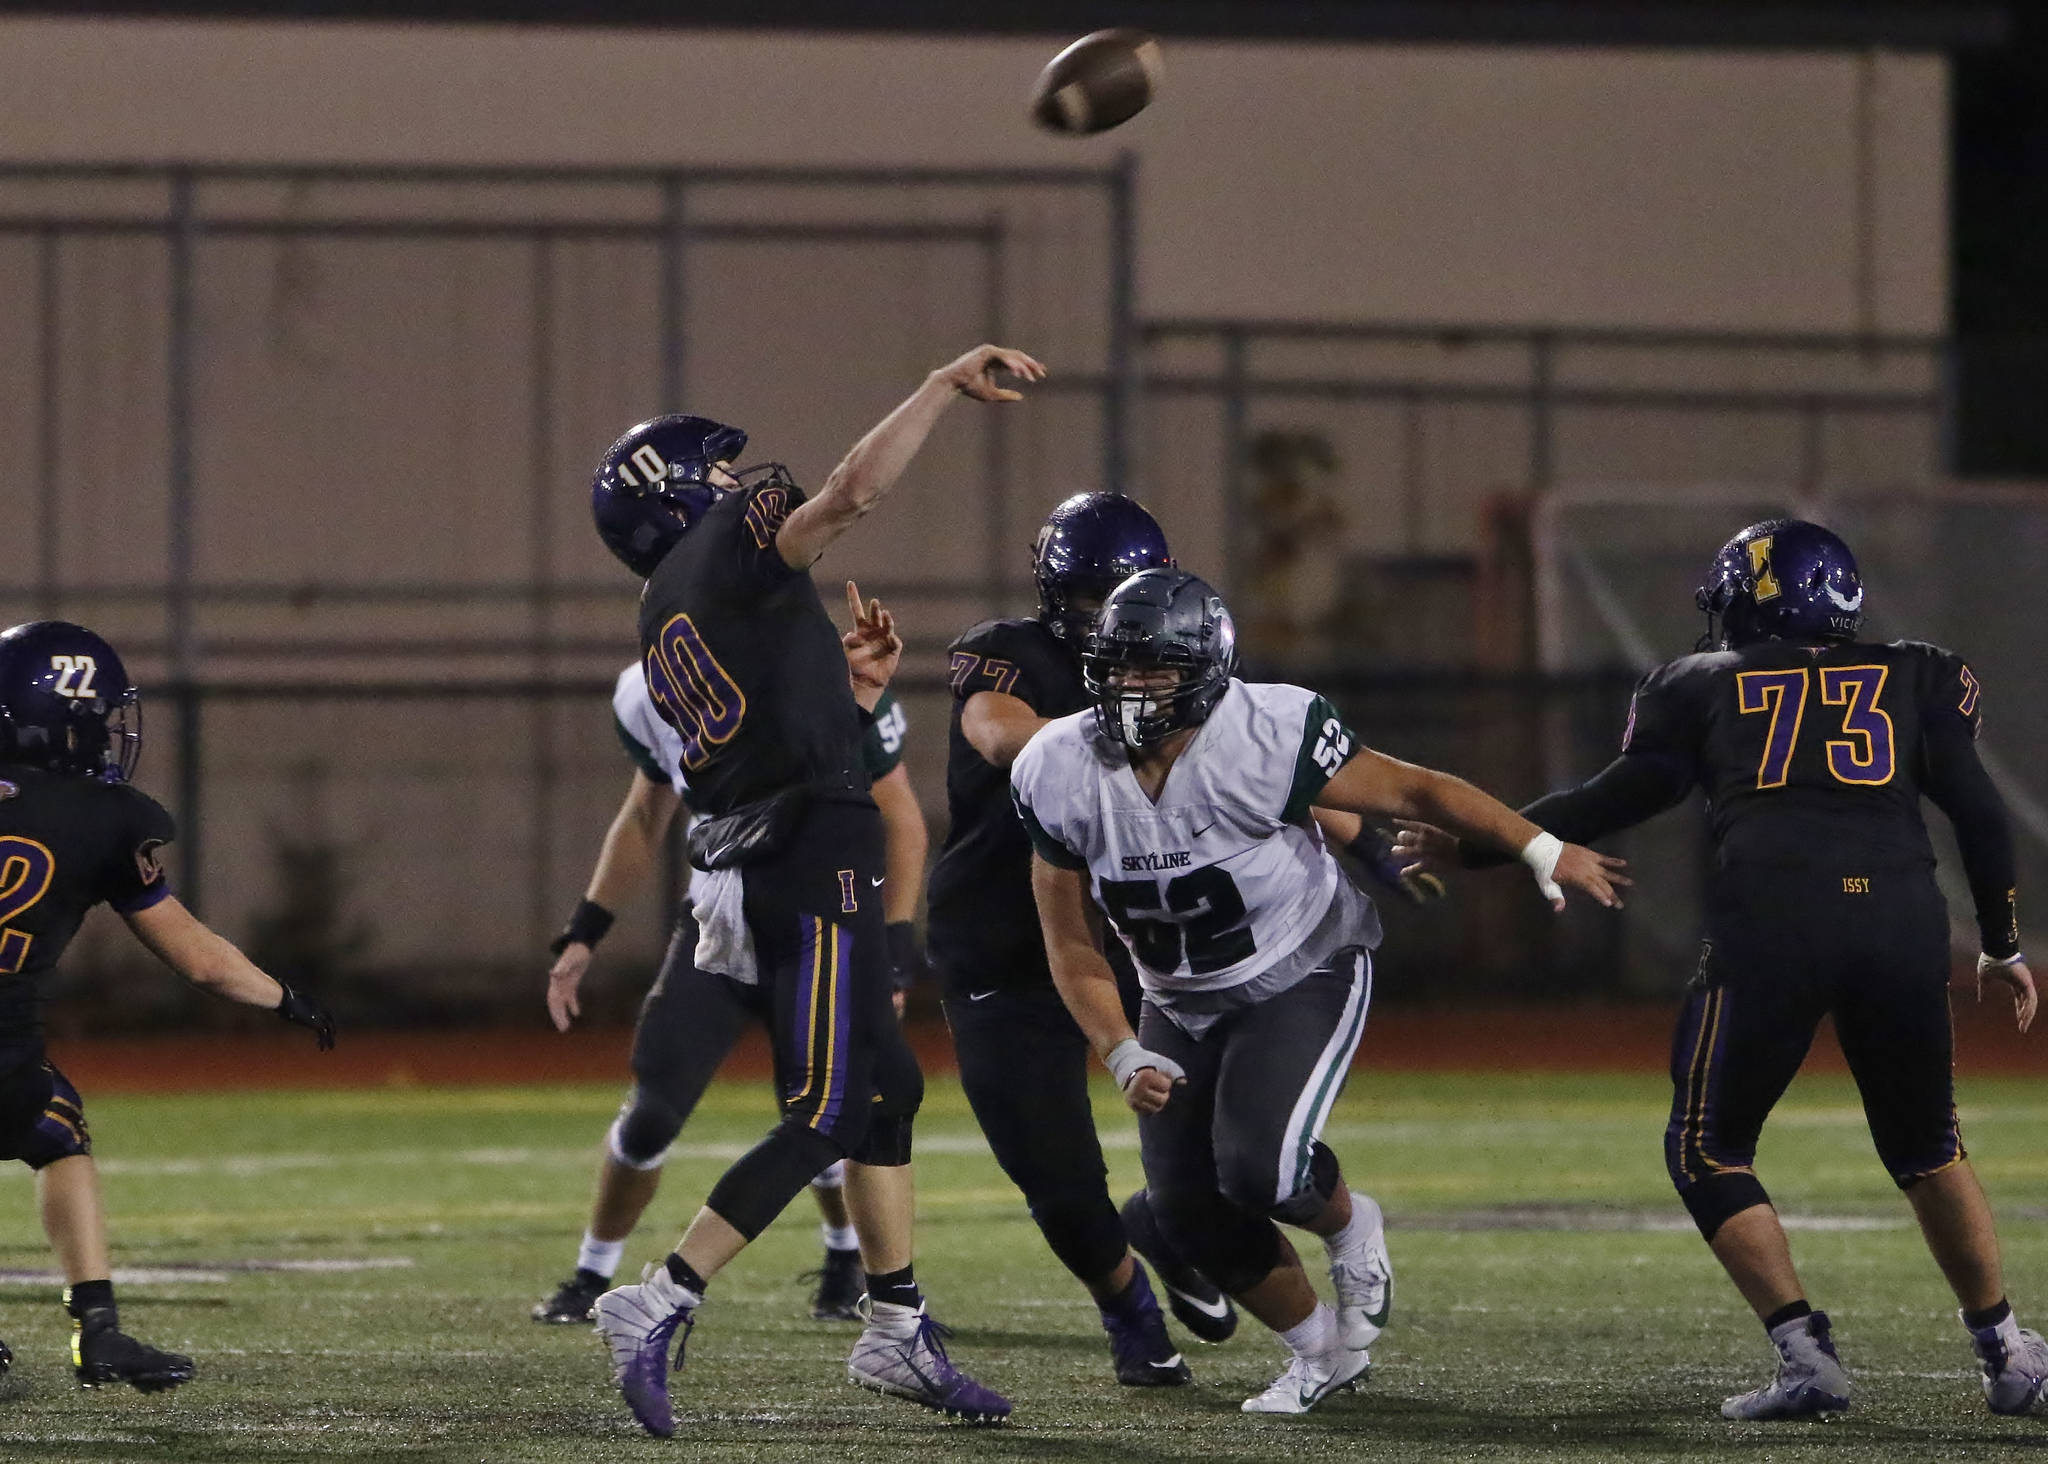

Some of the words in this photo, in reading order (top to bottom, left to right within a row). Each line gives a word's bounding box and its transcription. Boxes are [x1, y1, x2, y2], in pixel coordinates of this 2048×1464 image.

[618, 444, 668, 487] 10
[1746, 535, 1781, 605] I
[51, 655, 97, 699] 22
[646, 612, 746, 772] 10
[950, 651, 1021, 696] 77
[1312, 718, 1350, 779] 52
[1736, 664, 1896, 790] 73
[1121, 851, 1192, 872] SKYLINE
[837, 869, 858, 913] I
[1842, 878, 1870, 893] ISSY
[1099, 864, 1258, 977] 52
